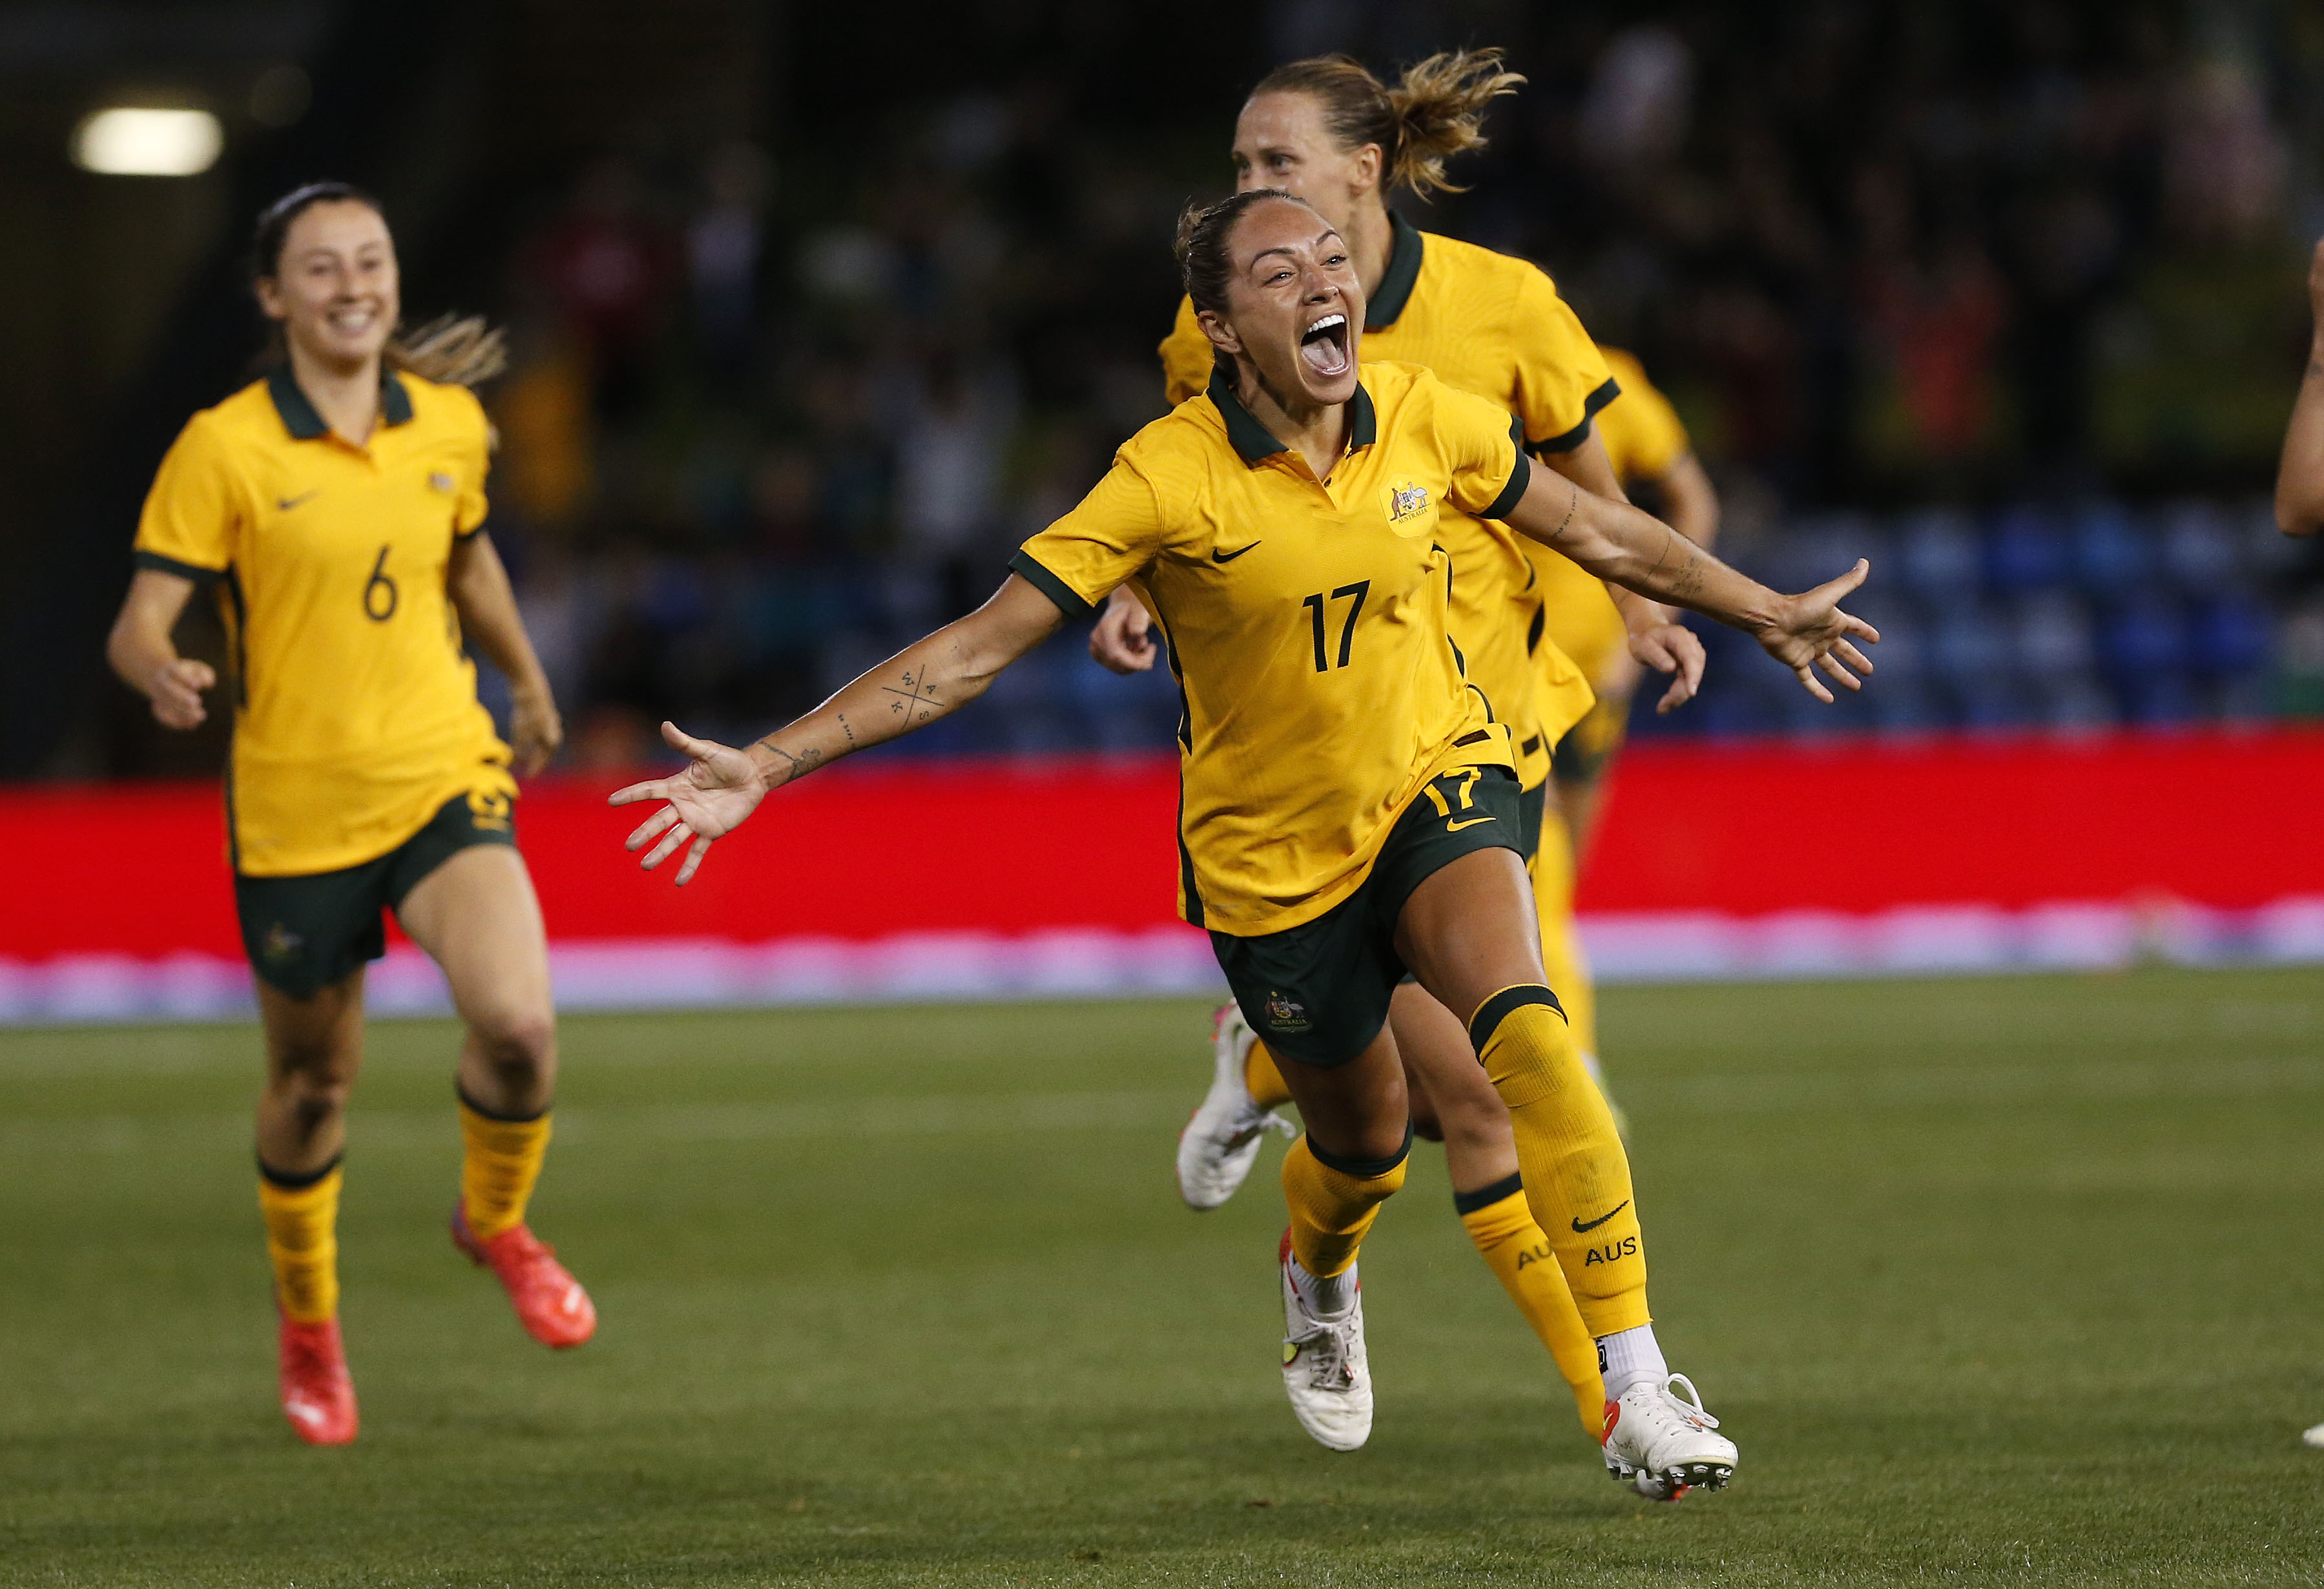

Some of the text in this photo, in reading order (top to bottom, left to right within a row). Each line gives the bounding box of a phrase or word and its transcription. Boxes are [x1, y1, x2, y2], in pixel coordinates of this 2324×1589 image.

[1398, 508, 1427, 524] AUSTRALIA
[363, 543, 398, 621] 6
[1303, 579, 1371, 672] 17
[902, 672, 915, 687] W
[926, 684, 937, 694] A
[891, 701, 904, 713] K
[919, 711, 929, 720] S
[1423, 766, 1482, 817] 17
[1519, 1240, 1553, 1271] AU
[1586, 1236, 1636, 1266] AUS
